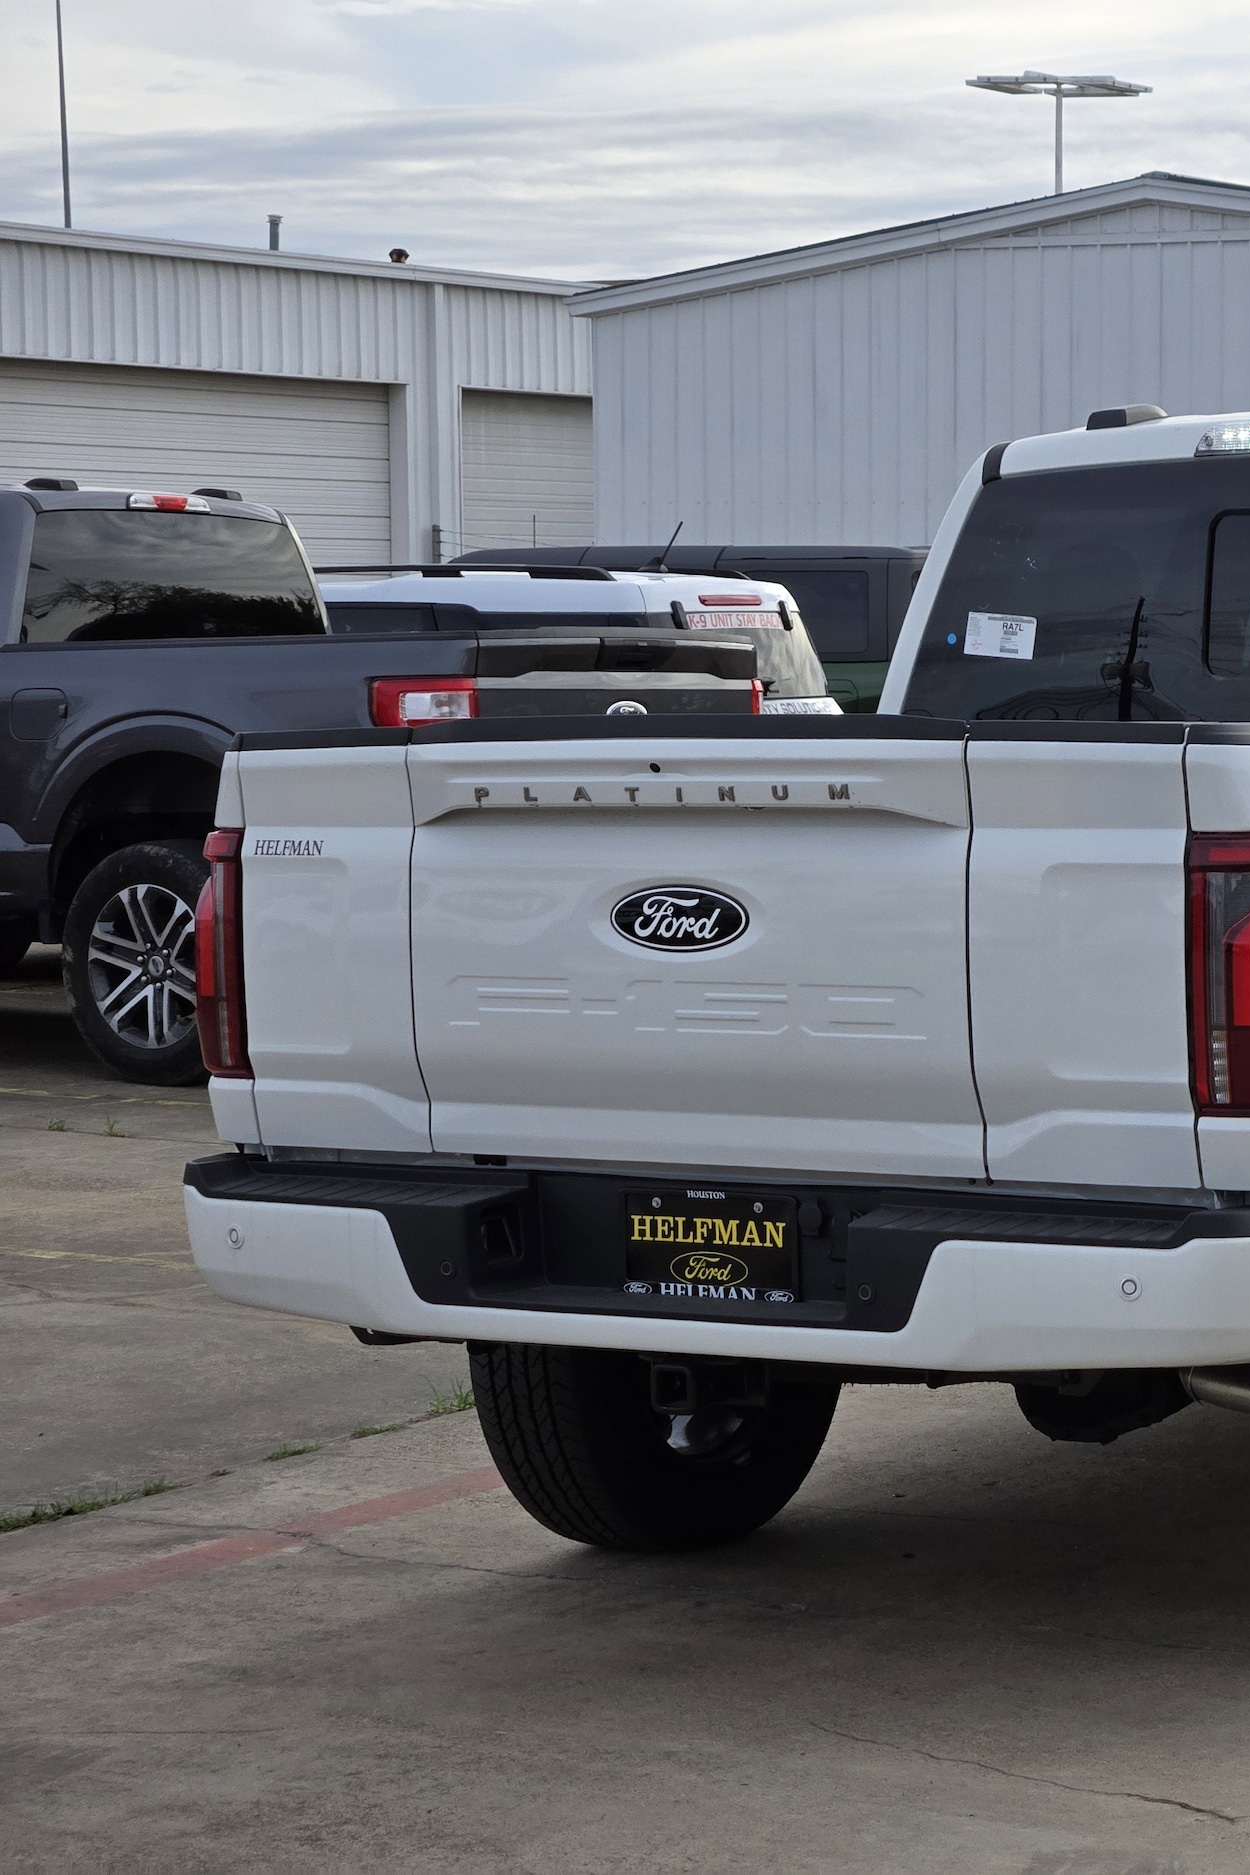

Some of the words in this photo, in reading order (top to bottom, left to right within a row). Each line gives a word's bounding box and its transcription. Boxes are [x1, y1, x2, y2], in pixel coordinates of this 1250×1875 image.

[688, 614, 707, 628] K-9
[709, 613, 733, 627] UNIT
[735, 613, 756, 627] STAY
[1002, 622, 1024, 632] RA7L
[473, 783, 851, 803] PLATINUM
[253, 839, 325, 856] HELFMAN
[633, 894, 723, 939] Ford
[686, 1189, 726, 1200] HOUSTON
[630, 1214, 787, 1248] HELFMAN
[684, 1255, 733, 1281] Ford
